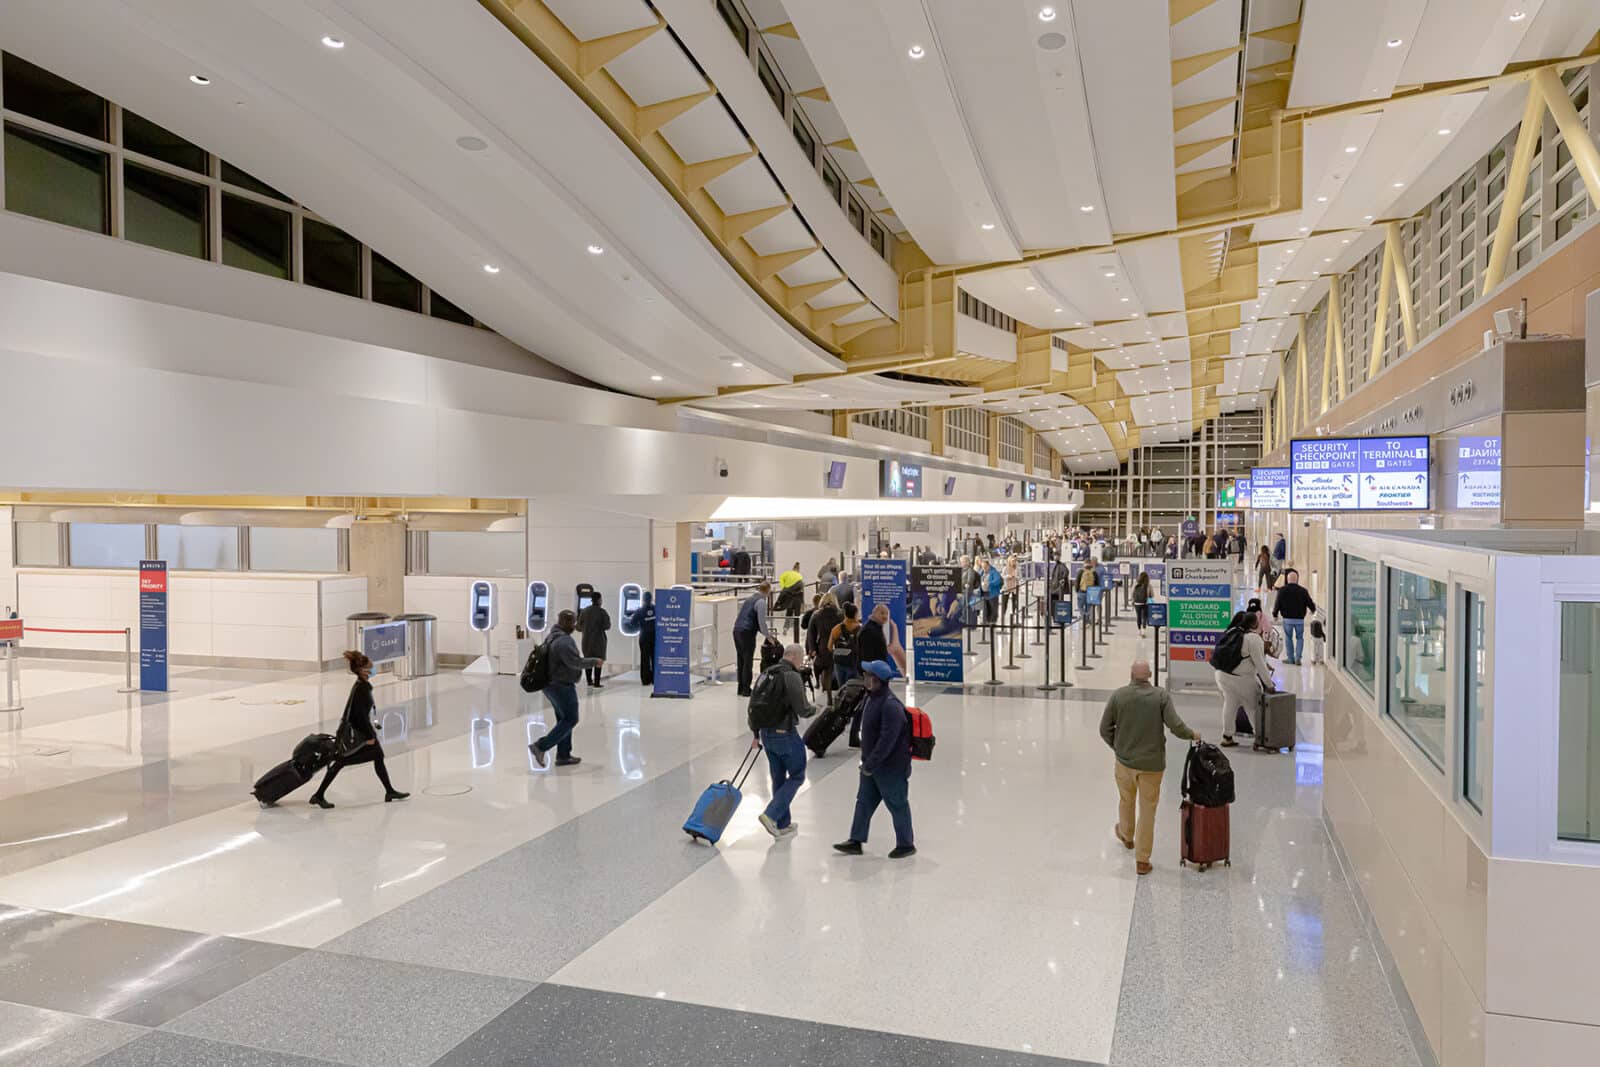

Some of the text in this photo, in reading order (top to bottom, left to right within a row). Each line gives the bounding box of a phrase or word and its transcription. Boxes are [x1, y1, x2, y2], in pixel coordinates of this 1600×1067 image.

[1302, 443, 1348, 452] SECURITY
[1294, 452, 1357, 462] CHECKPOINT
[1364, 450, 1415, 459] TERMINAL
